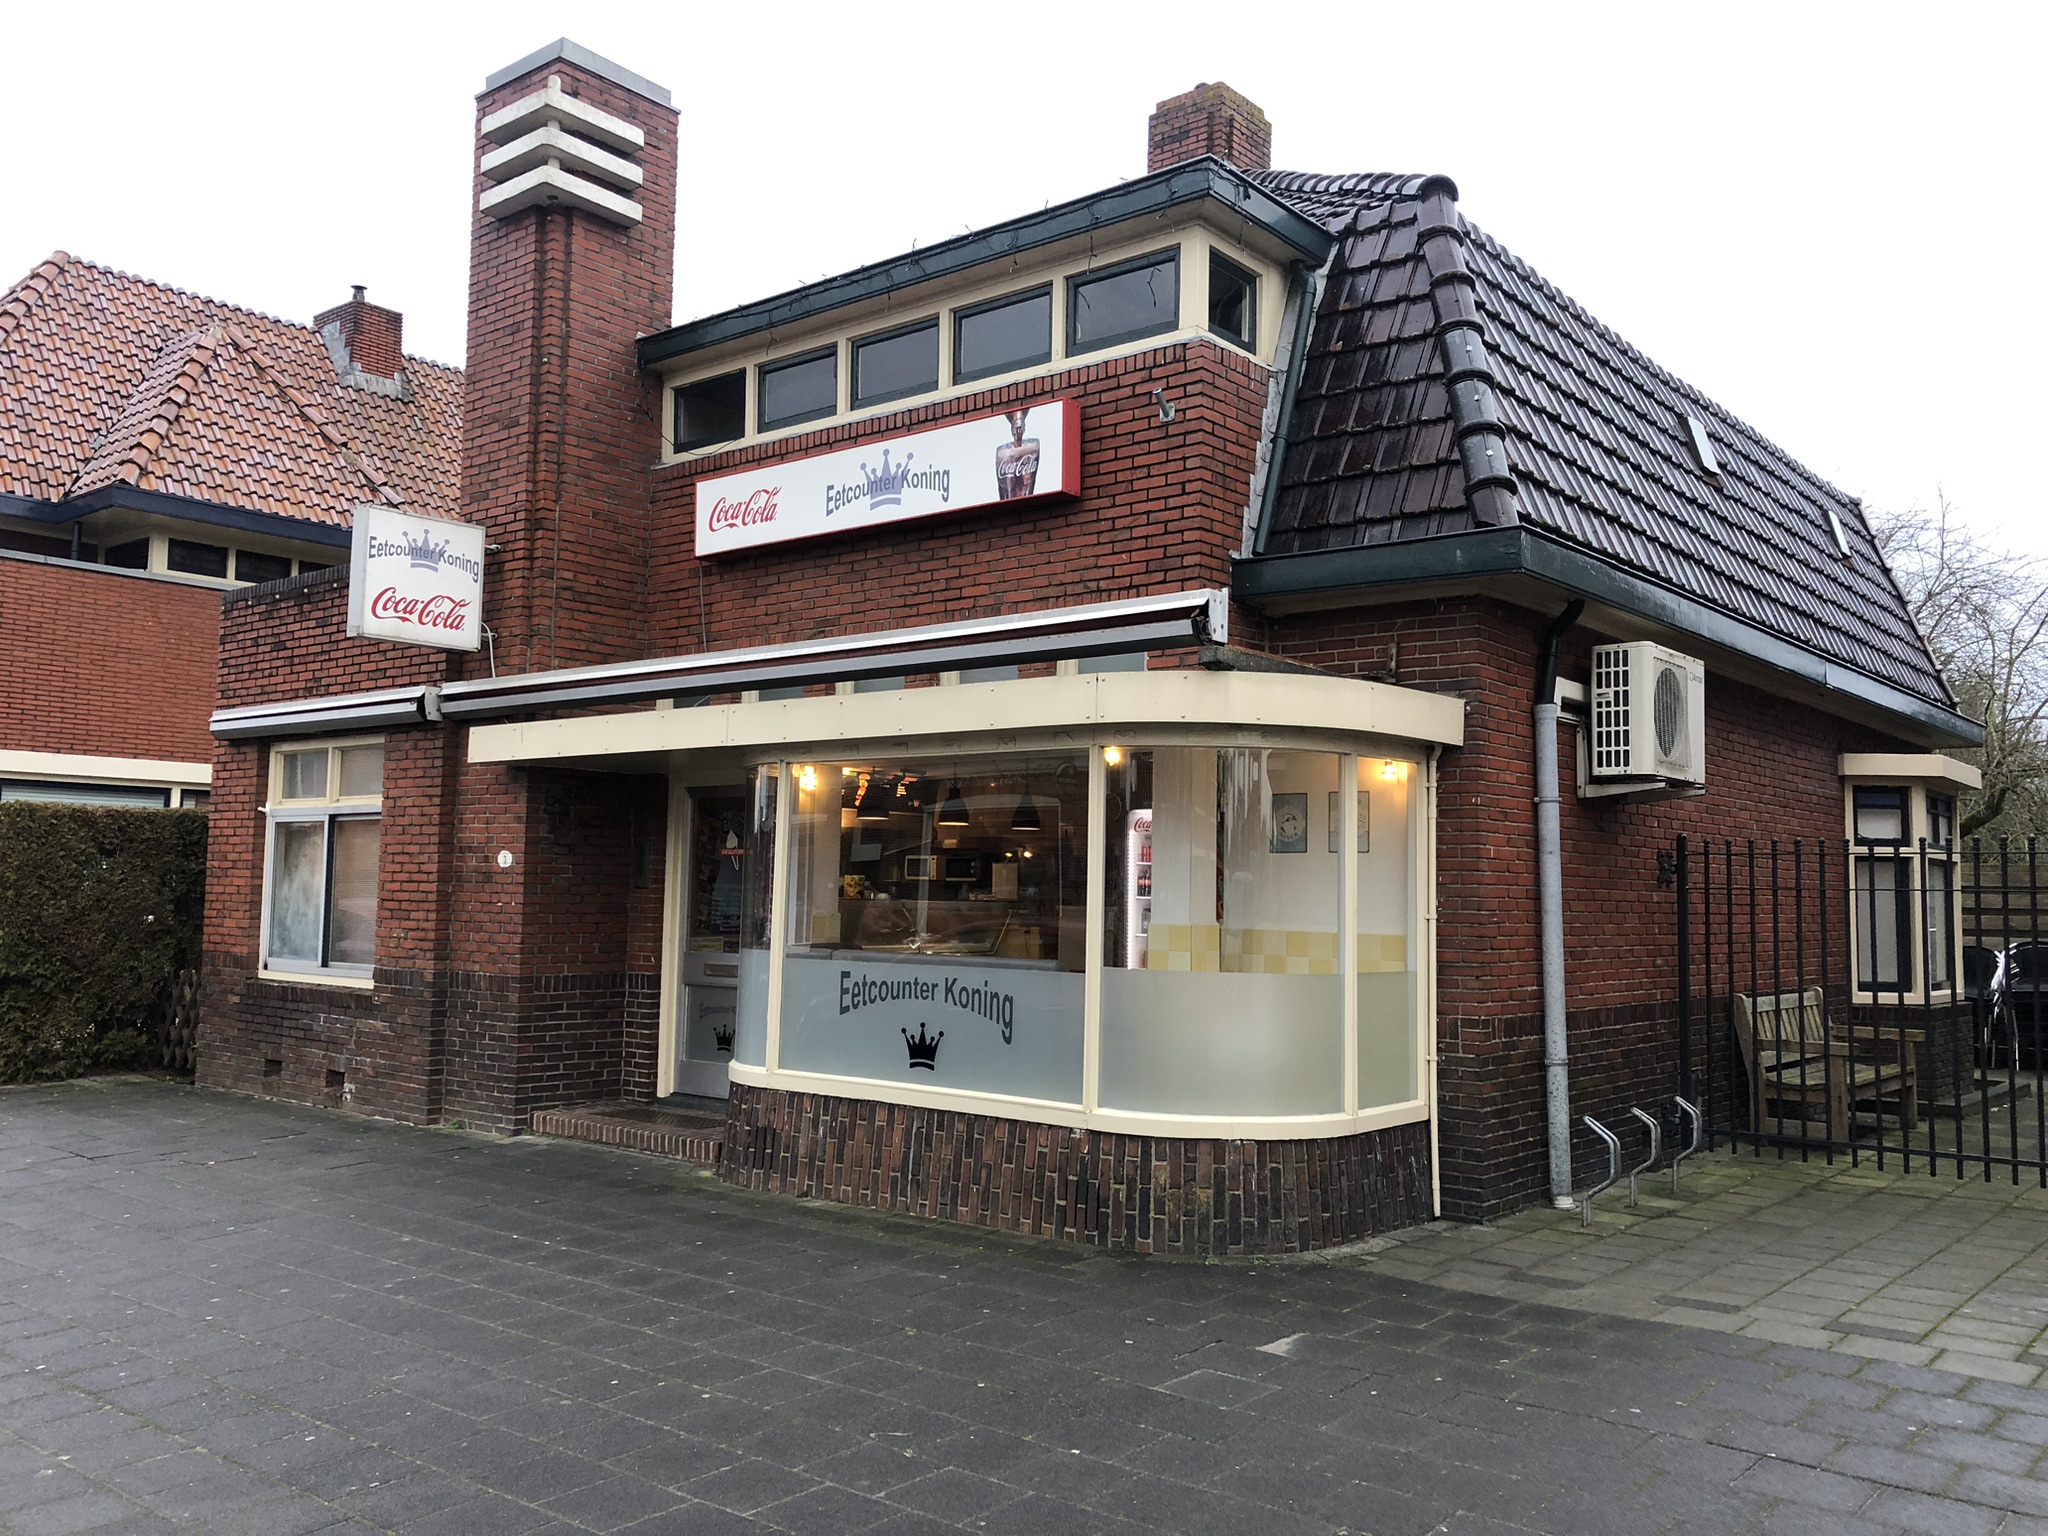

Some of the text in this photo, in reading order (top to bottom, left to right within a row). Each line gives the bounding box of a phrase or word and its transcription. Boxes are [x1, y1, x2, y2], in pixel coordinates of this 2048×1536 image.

[998, 453, 1038, 479] Coca-Cola
[709, 485, 783, 533] Coca-Cola
[826, 464, 950, 517] Eetcounter Koning
[368, 535, 480, 584] Eetcounter Koning
[371, 586, 472, 631] Coca-Cola
[839, 970, 1014, 1046] Eetcounter Koning
